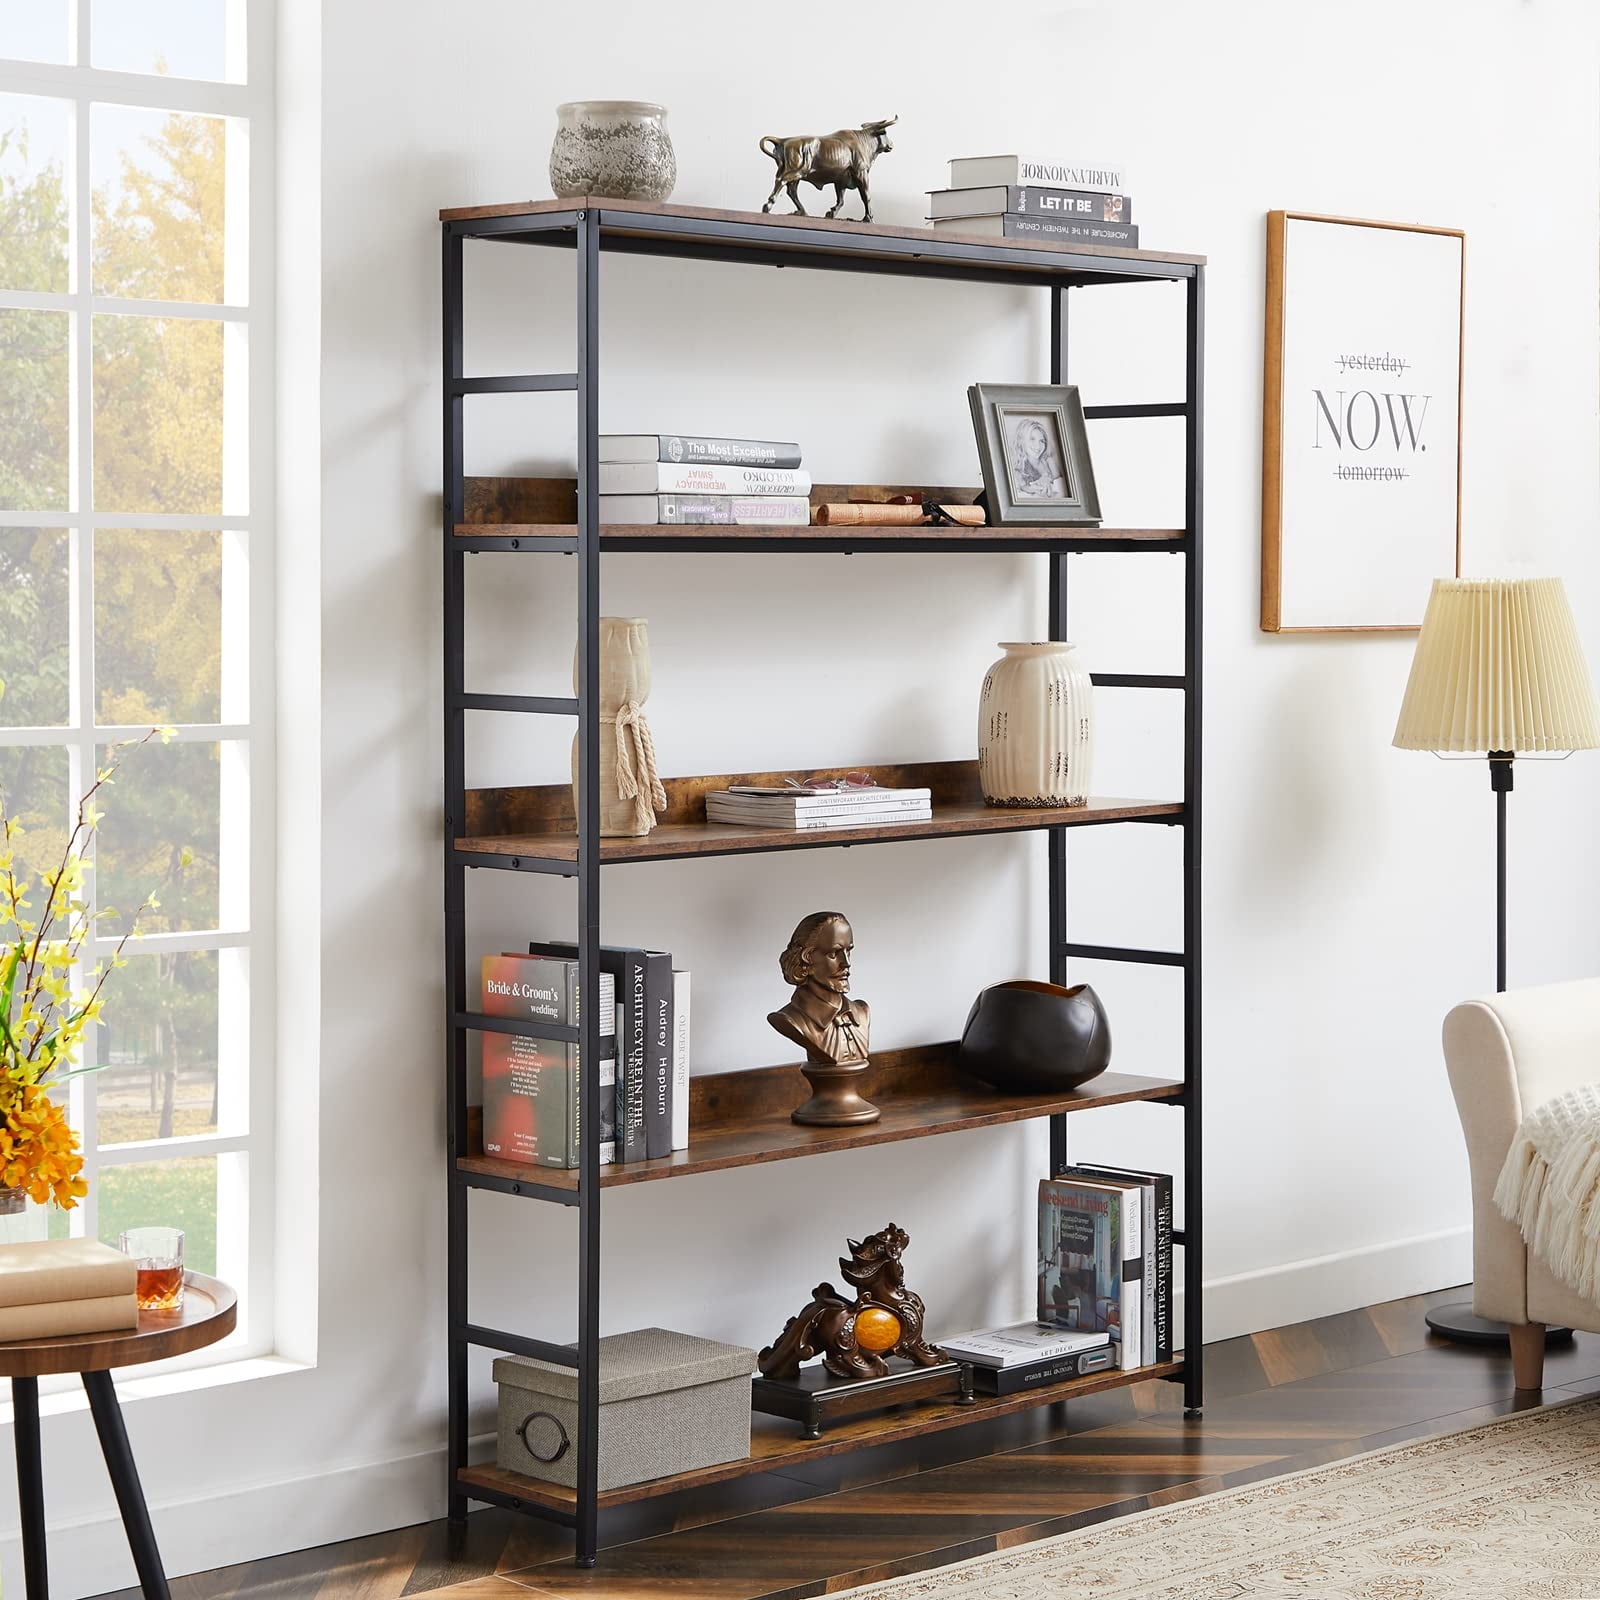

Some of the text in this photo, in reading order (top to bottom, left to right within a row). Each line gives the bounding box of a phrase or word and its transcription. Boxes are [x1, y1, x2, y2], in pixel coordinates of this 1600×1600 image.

[1021, 162, 1120, 187] MARILYN MONROE
[1040, 195, 1092, 213] LET IT BE
[1016, 222, 1041, 230] CENTURY
[1042, 224, 1069, 233] TWENTIETH
[1071, 227, 1081, 235] THE
[1091, 230, 1129, 239] ARCHITECTURE
[1340, 352, 1406, 378] yesterday
[1311, 390, 1433, 452] NOW.
[687, 442, 705, 454] The
[707, 443, 731, 456] Most
[733, 445, 777, 458] Excellent
[1337, 464, 1405, 481] tomorrow
[734, 504, 785, 518] HEARTLESS
[817, 794, 891, 805] CONTEMPORARY ARCHITECTURE
[487, 980, 559, 1002] Bride & Groom's
[530, 1004, 559, 1019] wedding
[634, 964, 644, 1127] ARCHITECYURE IN THE
[678, 1014, 687, 1087] OLIVER TWIST
[657, 999, 668, 1115] Audrey Hepburn
[627, 1051, 635, 1147] TWENTIETH CENTURY
[1079, 1193, 1109, 1217] Living
[1129, 1200, 1137, 1233] Weekend
[1158, 1207, 1166, 1350] ARCHITECYURE IN THE
[1040, 1345, 1073, 1357] ART DECO
